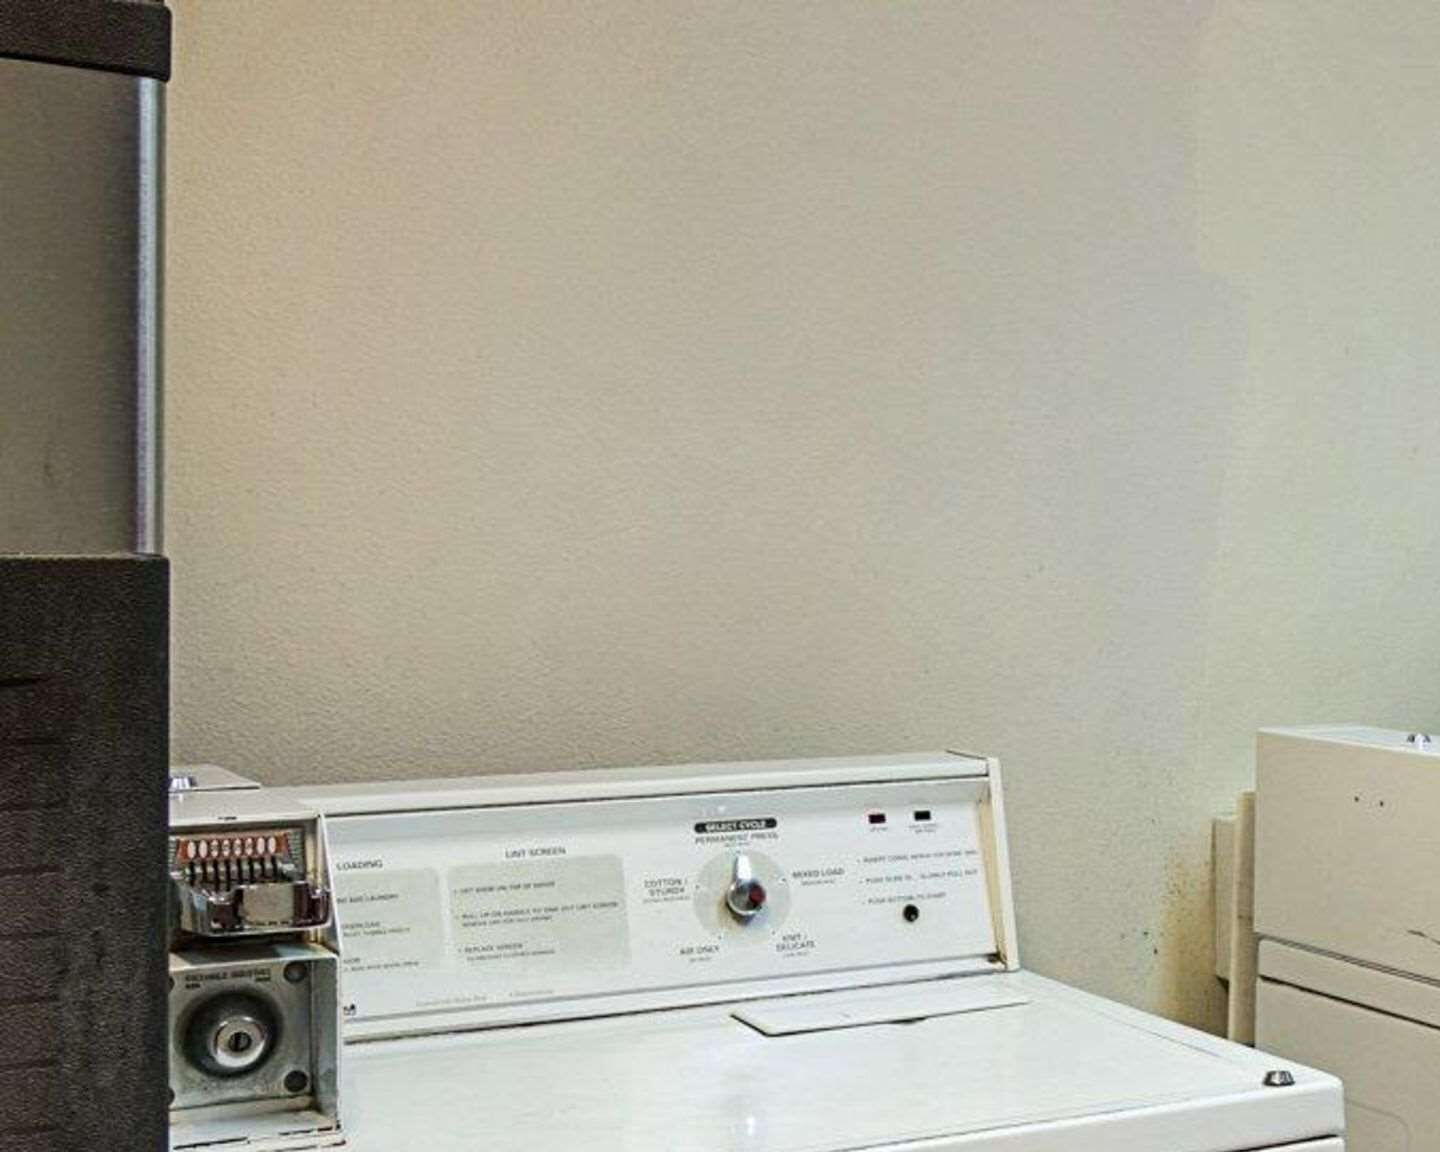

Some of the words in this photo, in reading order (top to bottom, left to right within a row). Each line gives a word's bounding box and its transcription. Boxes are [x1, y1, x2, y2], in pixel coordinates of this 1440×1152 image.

[704, 821, 736, 832] SELECT
[739, 819, 767, 830] CYCLE
[530, 847, 566, 857] SCREEN
[336, 859, 383, 871] LOADING
